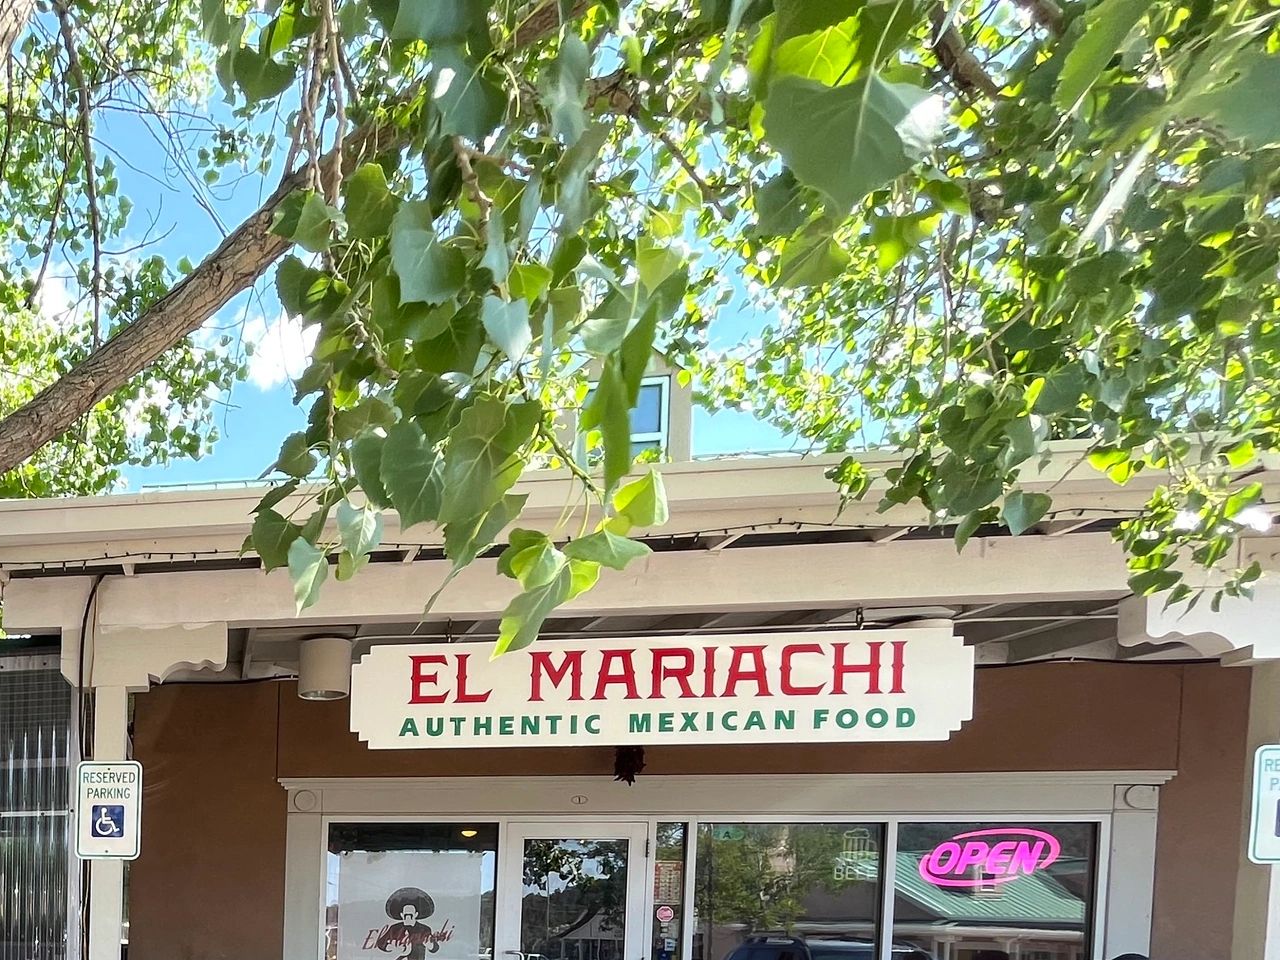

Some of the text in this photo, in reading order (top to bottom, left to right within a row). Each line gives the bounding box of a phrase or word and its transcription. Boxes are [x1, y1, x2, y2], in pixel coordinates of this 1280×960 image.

[407, 640, 909, 705] EL MARIACHI
[398, 707, 917, 737] AUTHENTIC MEXICAN FOOD
[82, 772, 136, 783] RESERVED
[86, 788, 131, 799] PARKING
[927, 840, 1046, 875] OPEN
[361, 924, 389, 950] El
